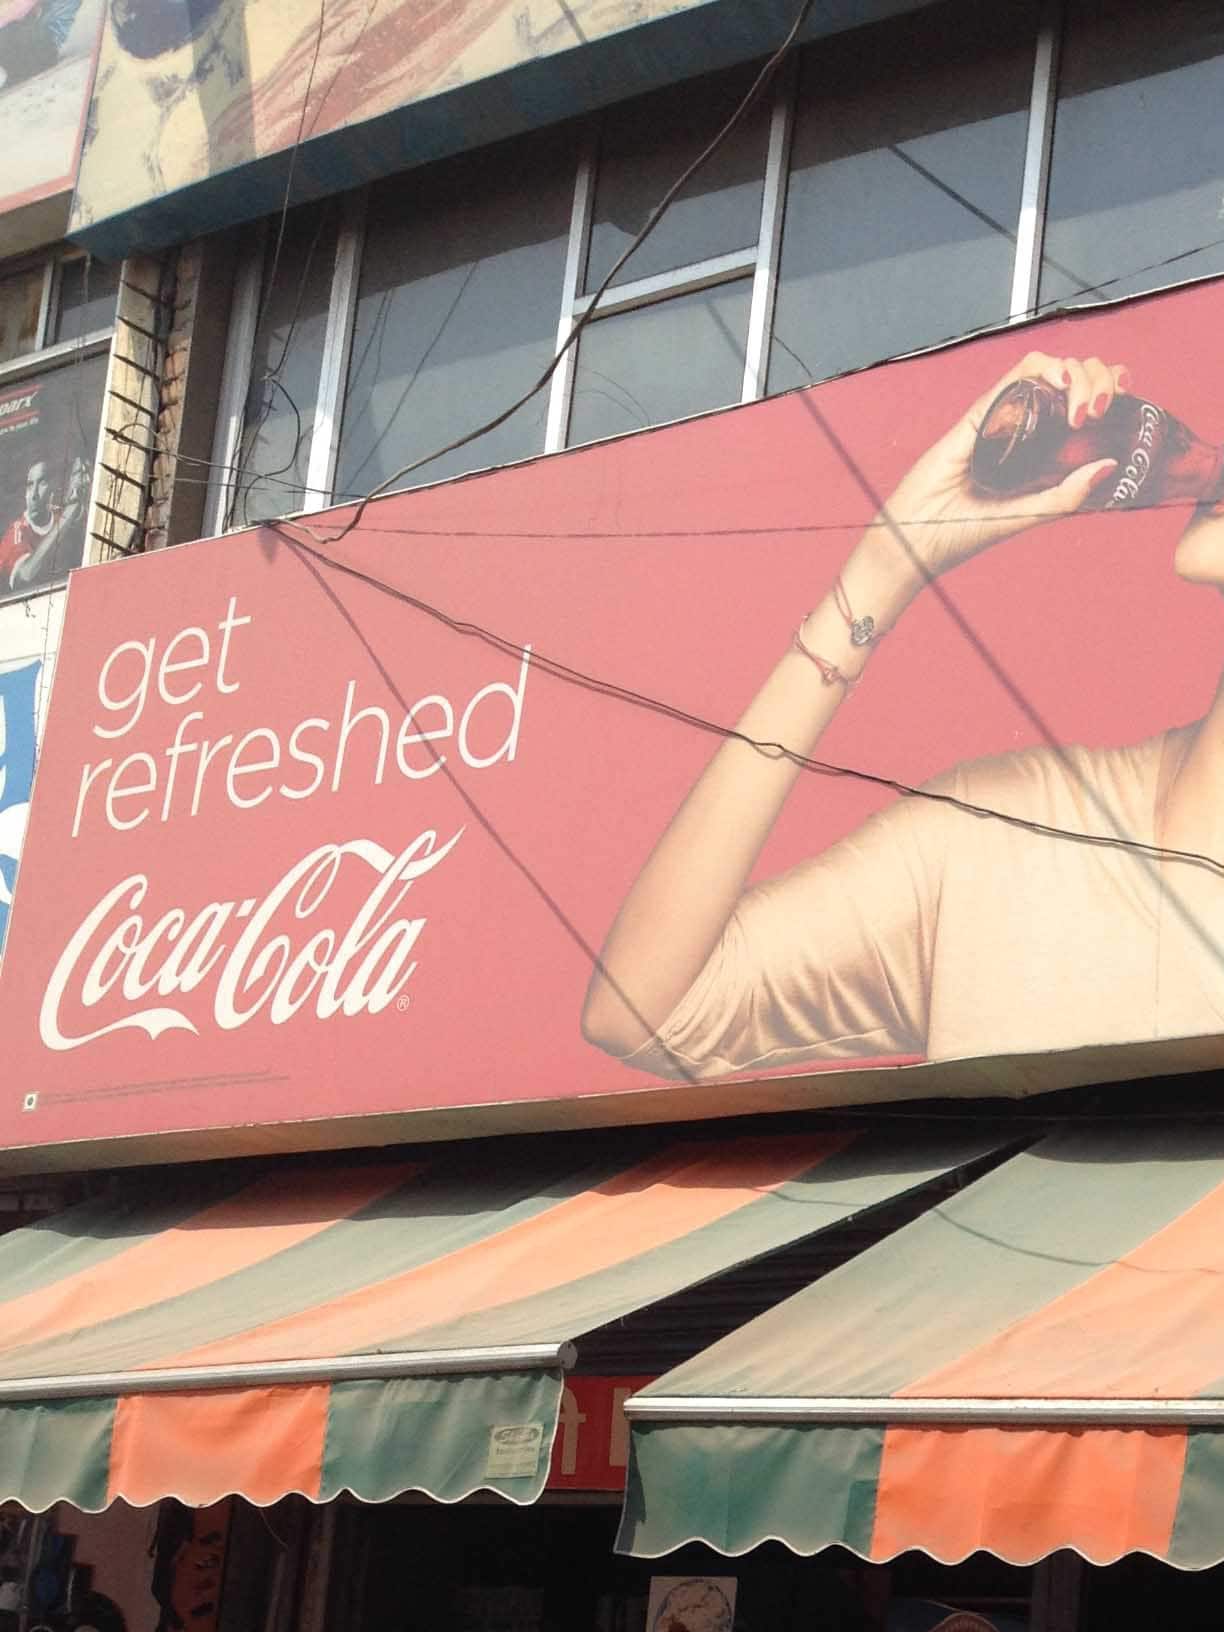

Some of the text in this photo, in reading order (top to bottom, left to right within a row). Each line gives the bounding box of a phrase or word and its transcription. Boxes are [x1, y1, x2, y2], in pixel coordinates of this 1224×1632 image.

[71, 643, 533, 838] refreshed
[92, 596, 252, 739] get
[39, 824, 466, 1052] Coca-Cola
